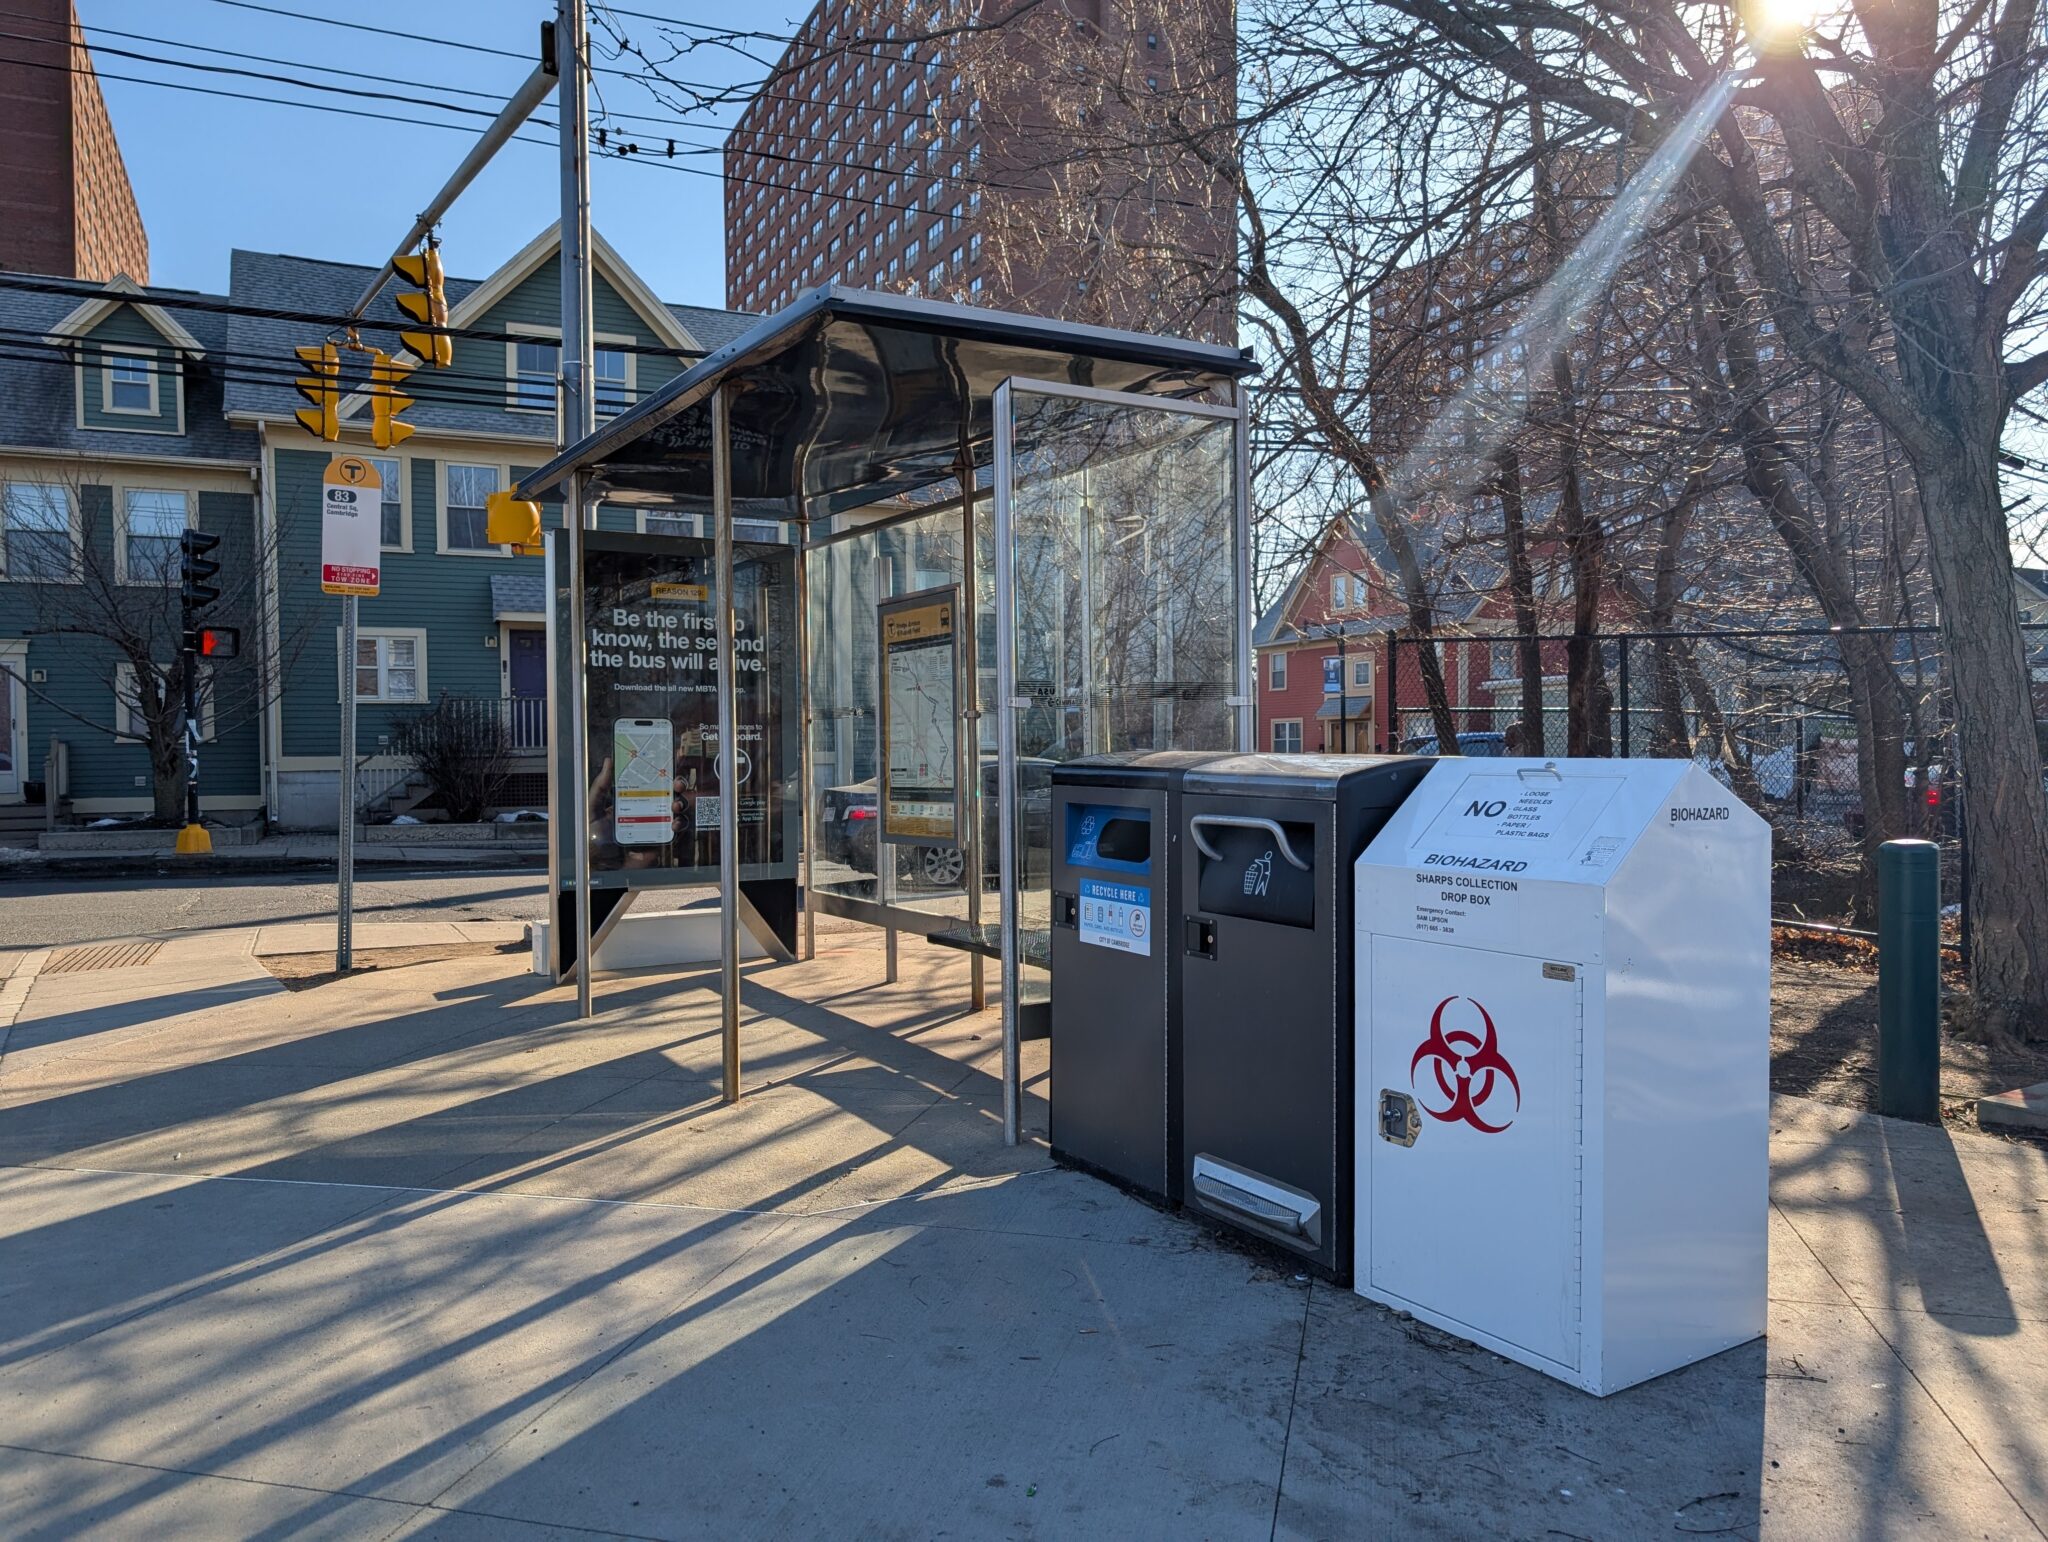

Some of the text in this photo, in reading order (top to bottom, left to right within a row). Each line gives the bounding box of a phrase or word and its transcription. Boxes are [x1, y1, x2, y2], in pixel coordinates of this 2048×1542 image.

[334, 491, 350, 502] 83
[326, 509, 358, 517] Cambridge
[655, 587, 689, 596] REASON
[613, 608, 640, 627] Be
[645, 610, 678, 628] the
[592, 629, 764, 652] know, the seond
[590, 649, 766, 672] the bus will aive.
[614, 683, 653, 692] Download
[654, 684, 666, 692] the
[667, 684, 677, 692] all
[695, 685, 717, 693] MBTA
[701, 732, 719, 741] Get
[1463, 800, 1507, 818] NO
[1671, 807, 1730, 821] BIOHAZARD
[1424, 853, 1528, 873] BIOHAZARD
[1416, 873, 1518, 891] SHARPS COLLECTION
[1091, 884, 1136, 902] RECYCLE HERE
[1441, 891, 1491, 906] DROP BOX
[1416, 905, 1467, 917] Emergency Contact:
[1428, 916, 1448, 924] LIPSON
[1416, 923, 1429, 932] (617)
[1111, 938, 1131, 948] CAMBRIDGE
